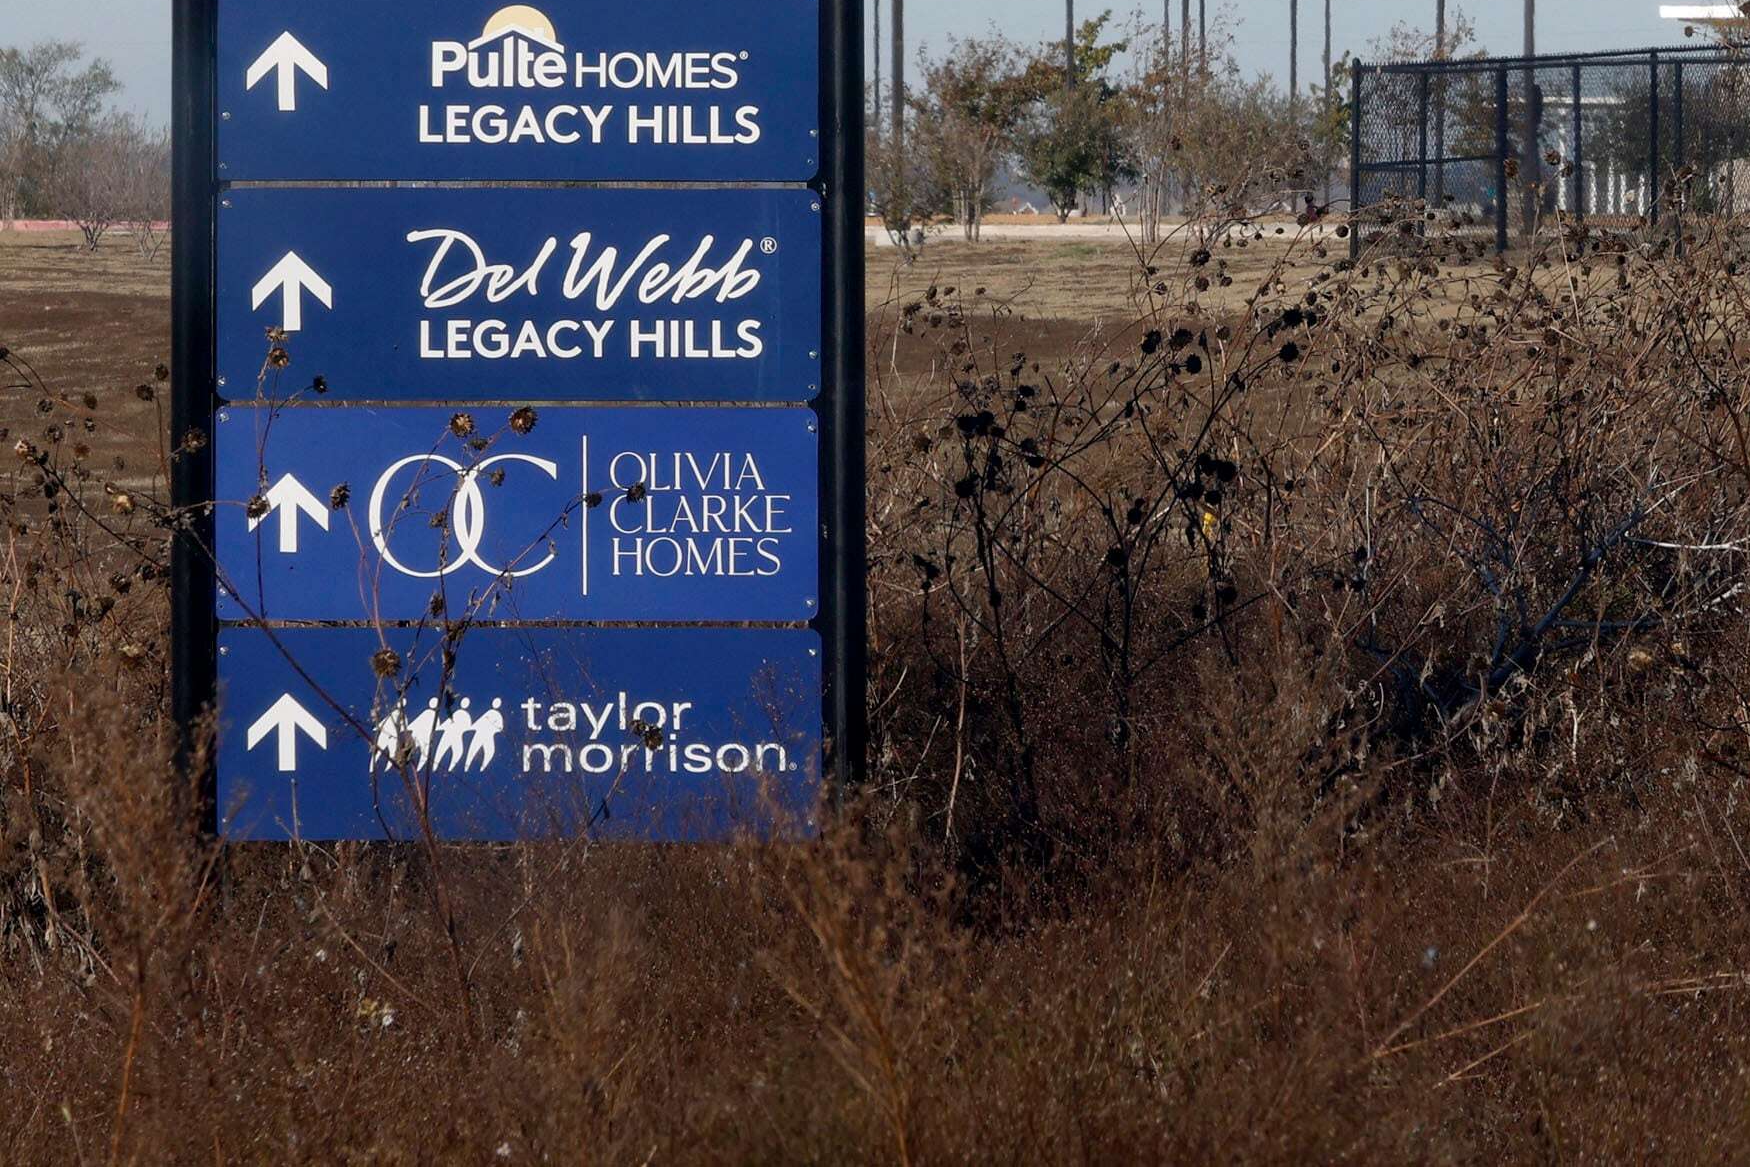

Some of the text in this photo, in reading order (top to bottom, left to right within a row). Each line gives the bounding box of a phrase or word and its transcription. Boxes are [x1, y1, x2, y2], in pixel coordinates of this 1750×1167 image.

[432, 40, 568, 88] Pulte
[419, 105, 761, 144] LEGACY HILLS
[406, 228, 557, 309] Del
[420, 320, 763, 358] LEGACY HILLS
[609, 451, 766, 491] OLIVIA
[609, 494, 793, 534] CLARKE
[612, 536, 782, 577] HOMES
[520, 691, 693, 741] taylor
